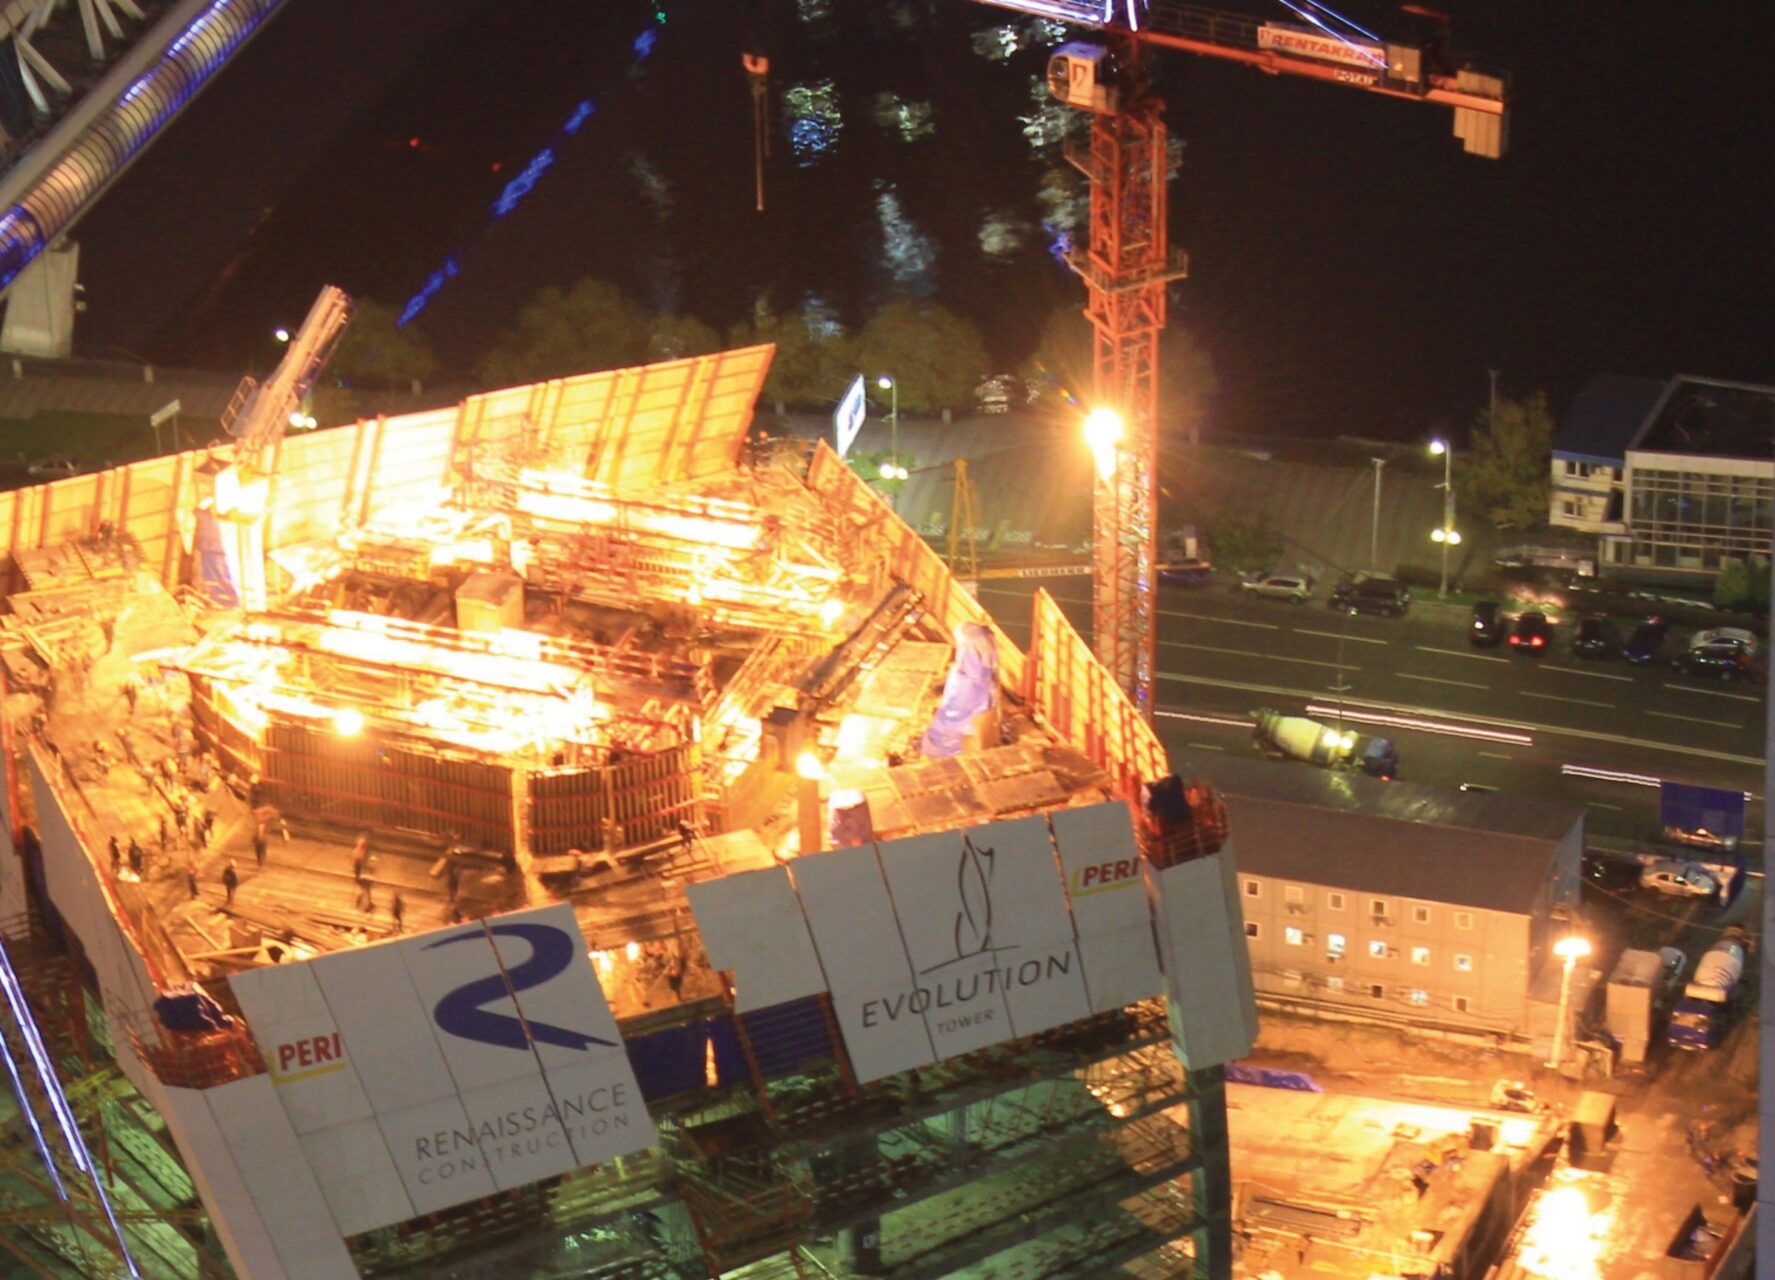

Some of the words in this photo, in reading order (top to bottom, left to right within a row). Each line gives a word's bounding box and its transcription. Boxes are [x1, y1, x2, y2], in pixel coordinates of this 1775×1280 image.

[1082, 856, 1139, 888] PERI
[861, 950, 1070, 1029] EVOLUTION
[937, 1009, 994, 1035] TOWER
[277, 1031, 342, 1072] PERI
[415, 1082, 627, 1161] RENAISSANCE
[417, 1111, 630, 1185] CONSTRUCTION
